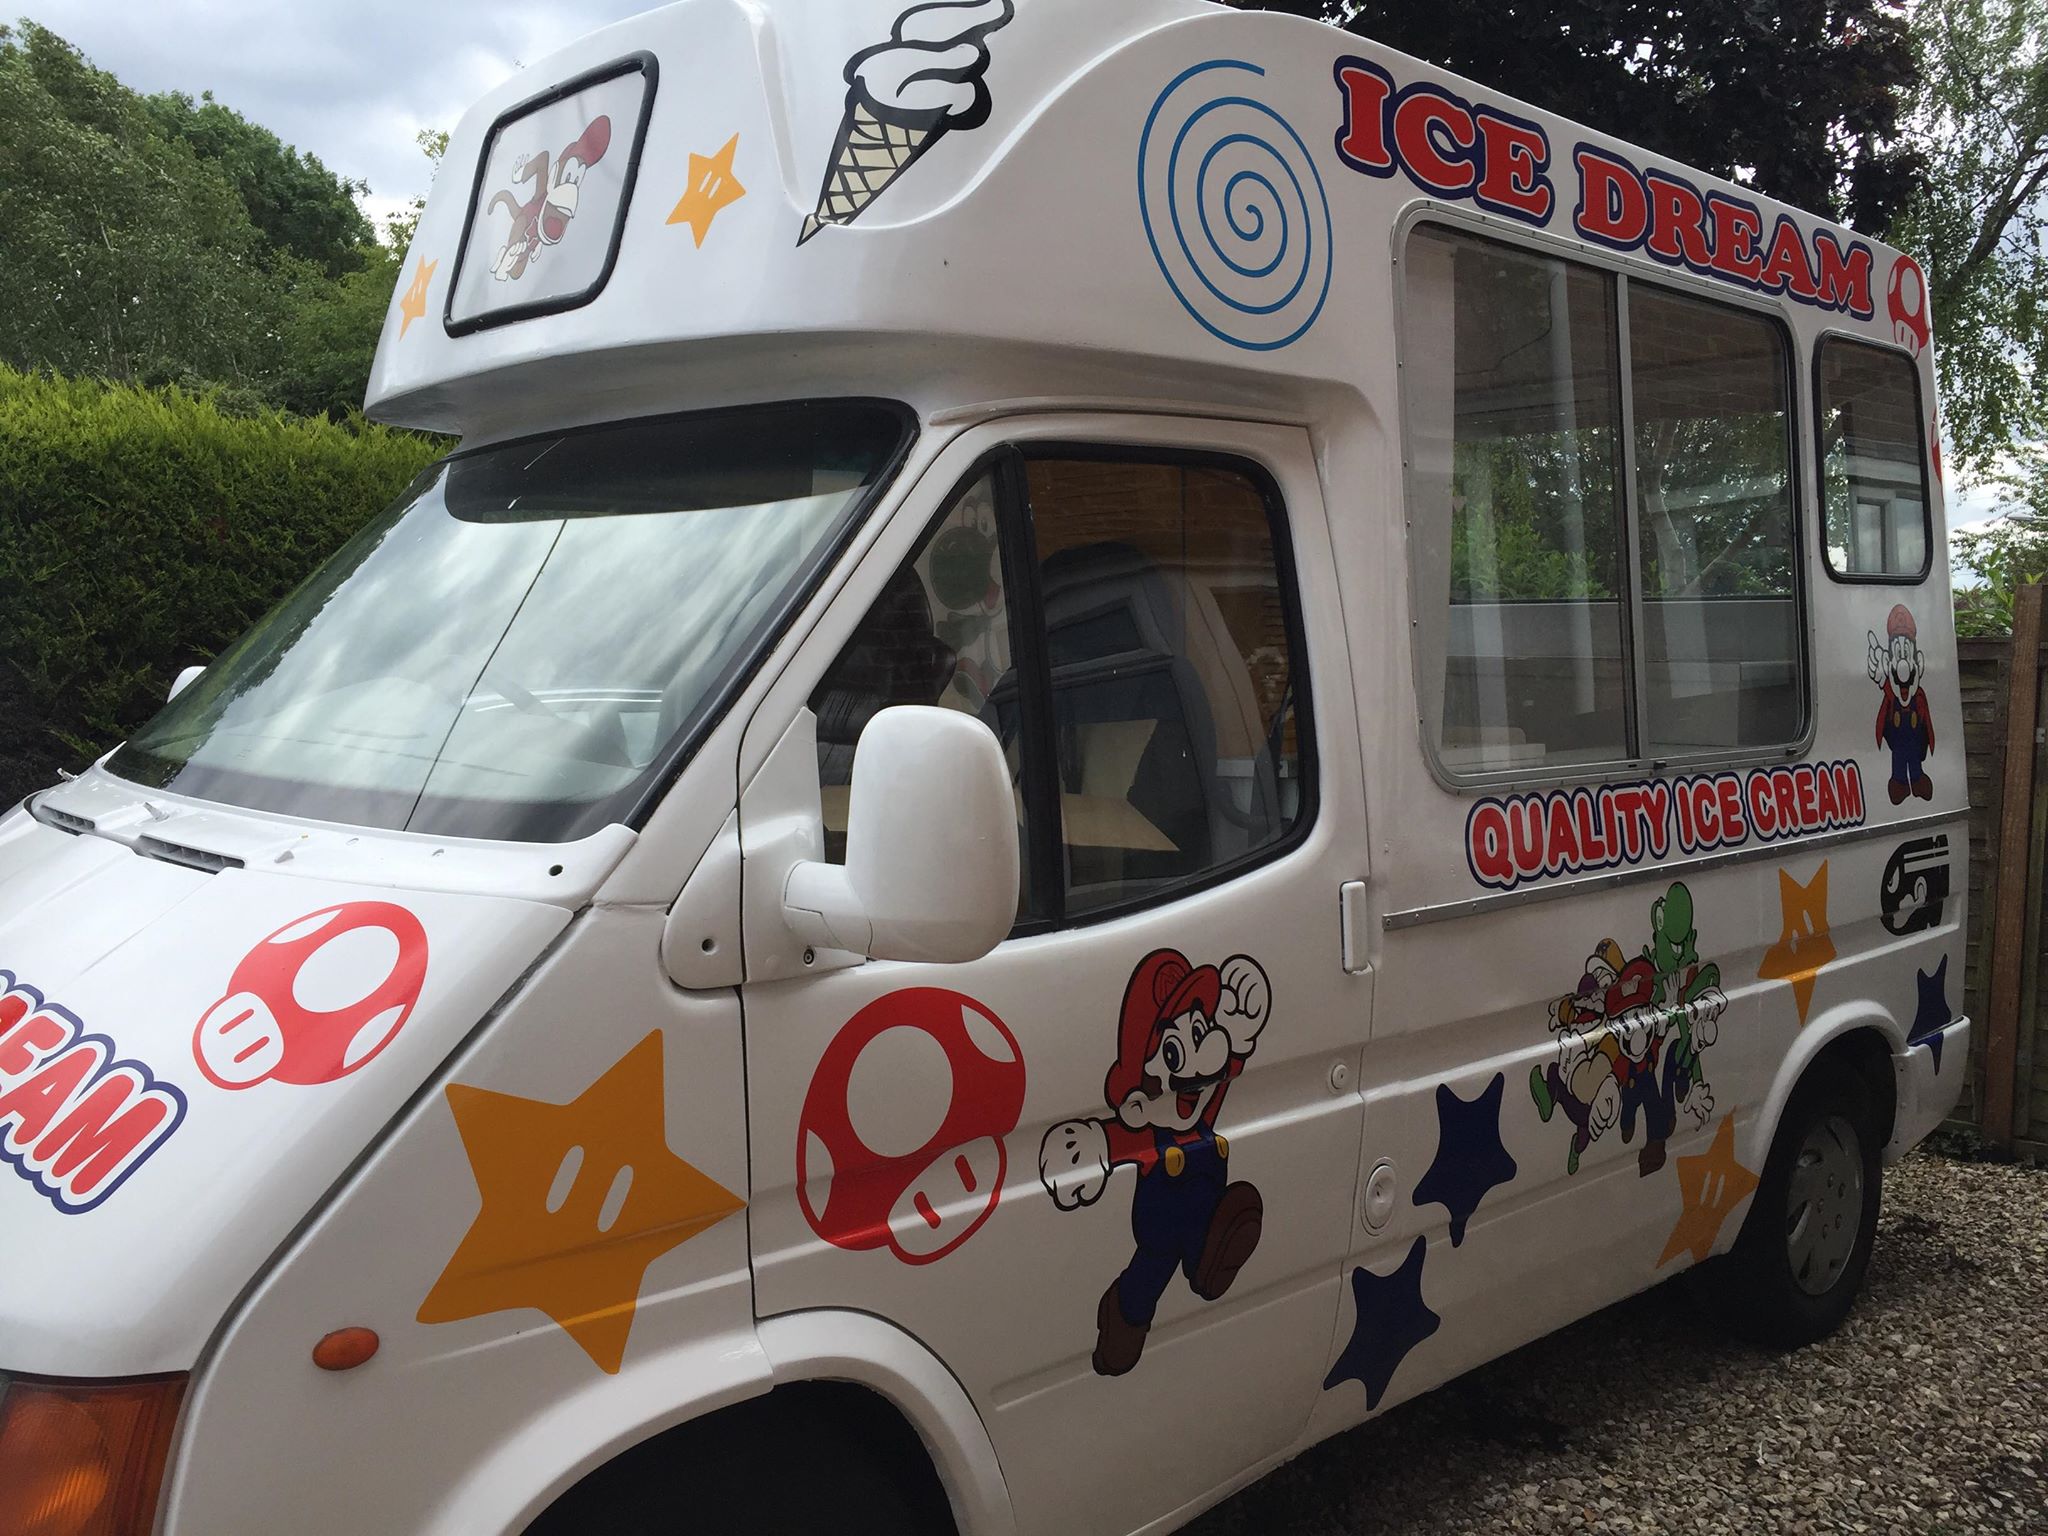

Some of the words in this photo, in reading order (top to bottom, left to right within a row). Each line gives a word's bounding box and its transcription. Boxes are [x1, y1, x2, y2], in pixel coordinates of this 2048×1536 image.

[1335, 56, 1554, 226] ICE
[1574, 142, 1876, 320] DREAM
[1467, 780, 1670, 888] QUALITY
[1674, 774, 1748, 850] ICE
[1749, 760, 1866, 838] CREAM
